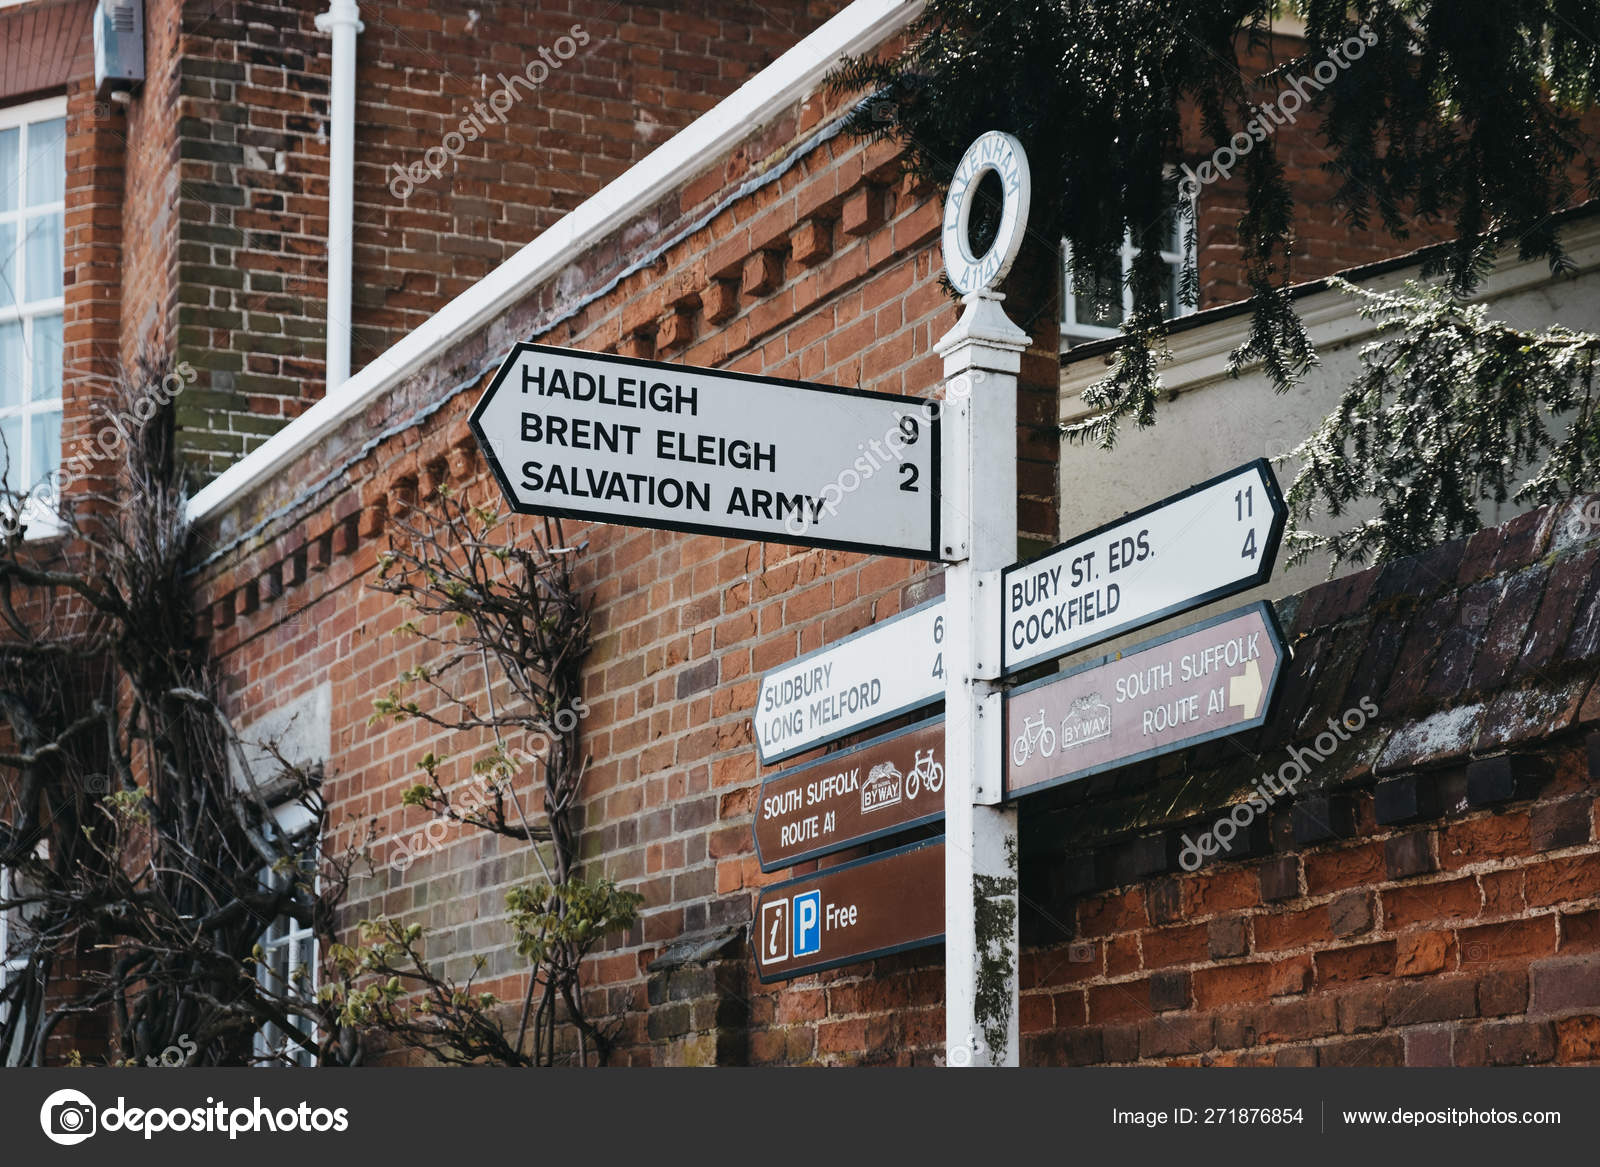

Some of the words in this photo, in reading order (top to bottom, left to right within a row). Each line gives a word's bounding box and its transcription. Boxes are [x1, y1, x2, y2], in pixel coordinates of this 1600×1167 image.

[947, 138, 1020, 231] LAVENHAM
[960, 250, 1002, 289] A1141
[521, 364, 698, 416] HADLEIGH
[521, 412, 641, 455] BRENT
[656, 430, 776, 473] ELEIGH
[899, 415, 919, 445] 9
[520, 461, 710, 512] SALVATION
[726, 487, 826, 525] ARMY
[899, 462, 919, 492] 2
[1234, 485, 1253, 522] 11
[1241, 528, 1258, 560] 4
[1012, 565, 1062, 613] BURY
[1070, 551, 1100, 588] ST.
[1109, 529, 1155, 574] EDS.
[933, 615, 944, 644] 6
[1012, 583, 1120, 651] COCKFIELD
[765, 662, 833, 713] SUDBURY
[932, 652, 944, 680] 4
[1115, 662, 1173, 704] SOUTH
[1180, 632, 1260, 683] SUFFOLK
[764, 709, 803, 746] LONG
[809, 678, 881, 729] MELFORD
[1065, 716, 1107, 742] BYWAY
[1143, 695, 1199, 736] ROUTE
[1207, 686, 1225, 716] A1
[763, 788, 802, 820] SOUTH
[806, 768, 860, 806] SUFFOLK
[864, 782, 899, 806] BYWAY
[781, 816, 819, 848] ROUTE
[823, 810, 836, 834] A1
[826, 903, 858, 931] Free
